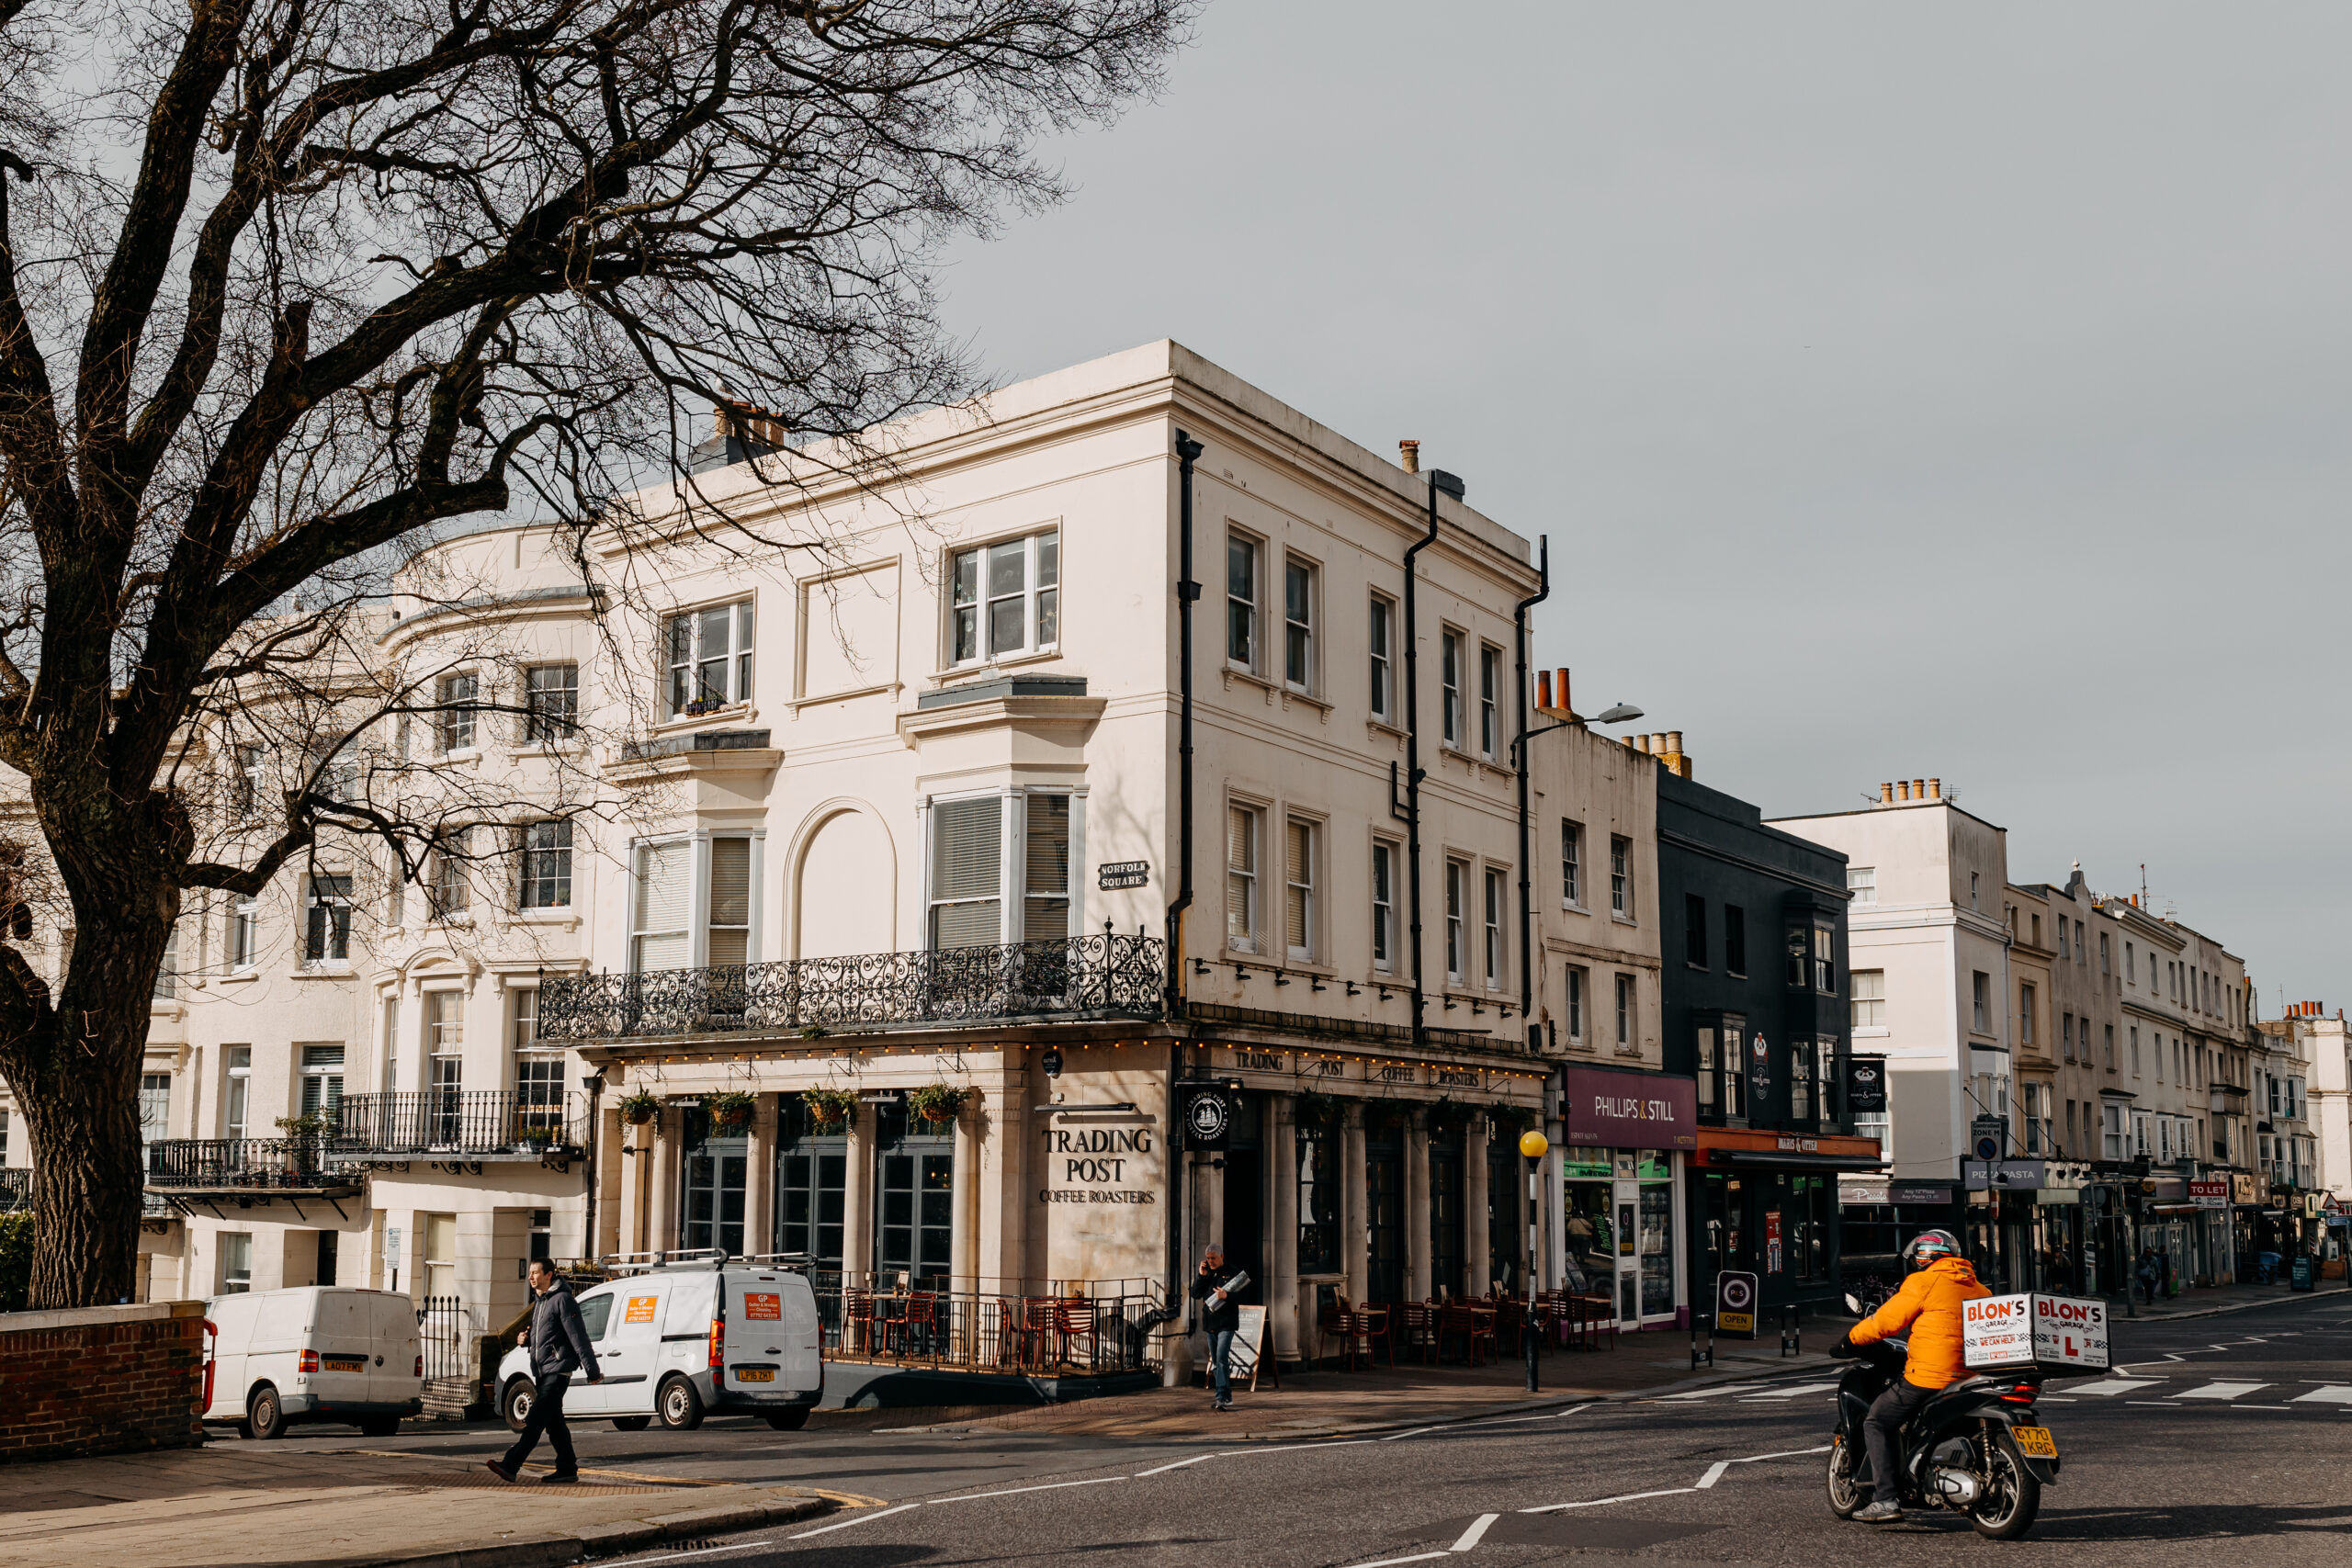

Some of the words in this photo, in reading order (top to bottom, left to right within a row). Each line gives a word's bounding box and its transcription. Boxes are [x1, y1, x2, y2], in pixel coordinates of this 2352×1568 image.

[1102, 863, 1146, 874] NORFOLK
[1102, 875, 1142, 887] SQUARE
[1236, 1052, 1283, 1071] TRADING
[1321, 1060, 1345, 1077] POST
[1383, 1066, 1415, 1082] COFFEE
[1439, 1070, 1479, 1088] ROASTERS
[1188, 1091, 1212, 1108] TRADING
[1213, 1093, 1227, 1108] POST
[1595, 1096, 1638, 1119] PHILLIPS
[1639, 1100, 1647, 1120] &
[1648, 1100, 1675, 1122] STILL
[1204, 1118, 1228, 1141] ROASTERS
[1042, 1128, 1153, 1154] TRADING
[1066, 1157, 1127, 1182] POST
[1039, 1189, 1086, 1204] COFFEE
[1088, 1190, 1156, 1204] ROASTERS
[639, 1298, 648, 1306] GP
[1968, 1300, 2025, 1322] BLON'S
[2038, 1298, 2102, 1323] BLON'S
[1724, 1314, 1747, 1324] OPEN
[1985, 1319, 2007, 1328] GARAGE
[2059, 1321, 2084, 1330] GARAGE
[741, 1370, 757, 1380] LP16
[759, 1370, 772, 1380] ZHT
[2015, 1427, 2049, 1440] GY70
[2027, 1441, 2052, 1455] KRG
